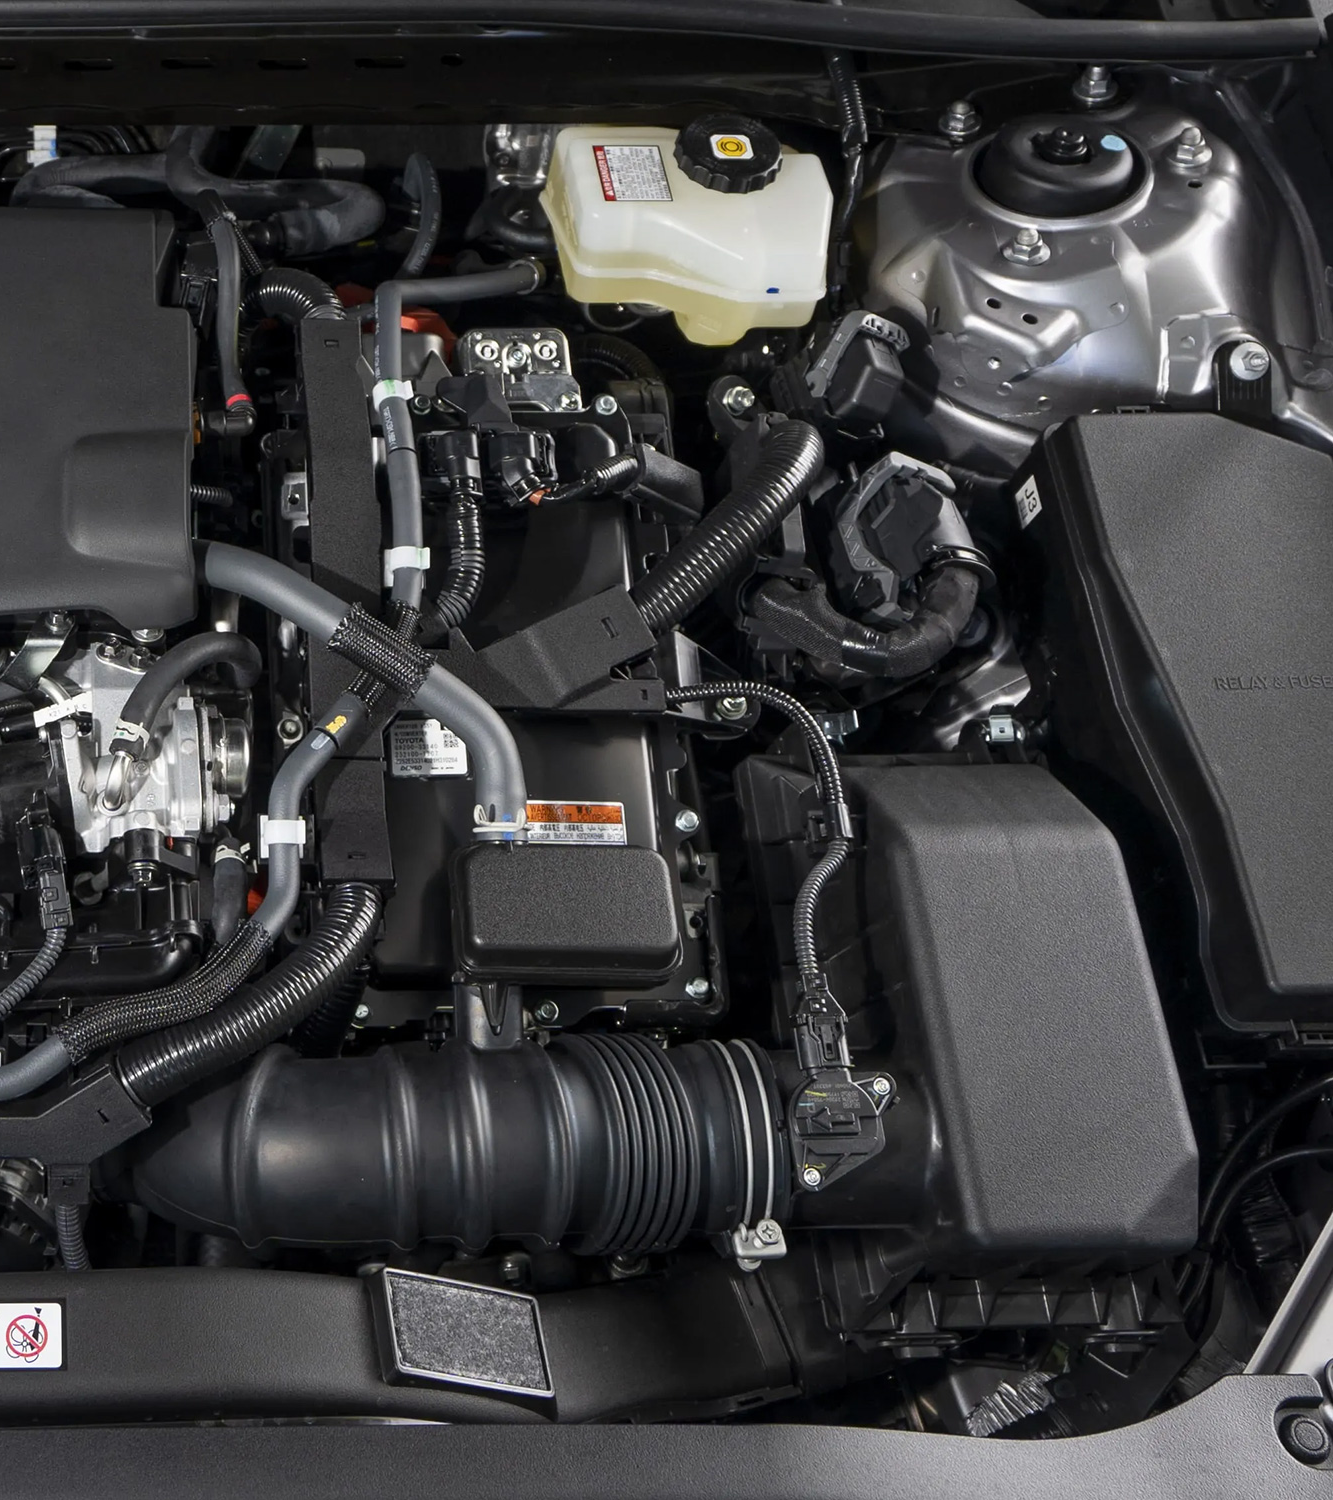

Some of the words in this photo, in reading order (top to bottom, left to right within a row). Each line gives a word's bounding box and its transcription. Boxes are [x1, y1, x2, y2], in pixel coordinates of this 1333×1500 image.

[1024, 488, 1038, 513] J3
[1214, 676, 1267, 690] RELAY
[1273, 676, 1285, 689] &
[1288, 675, 1333, 689] FUSE
